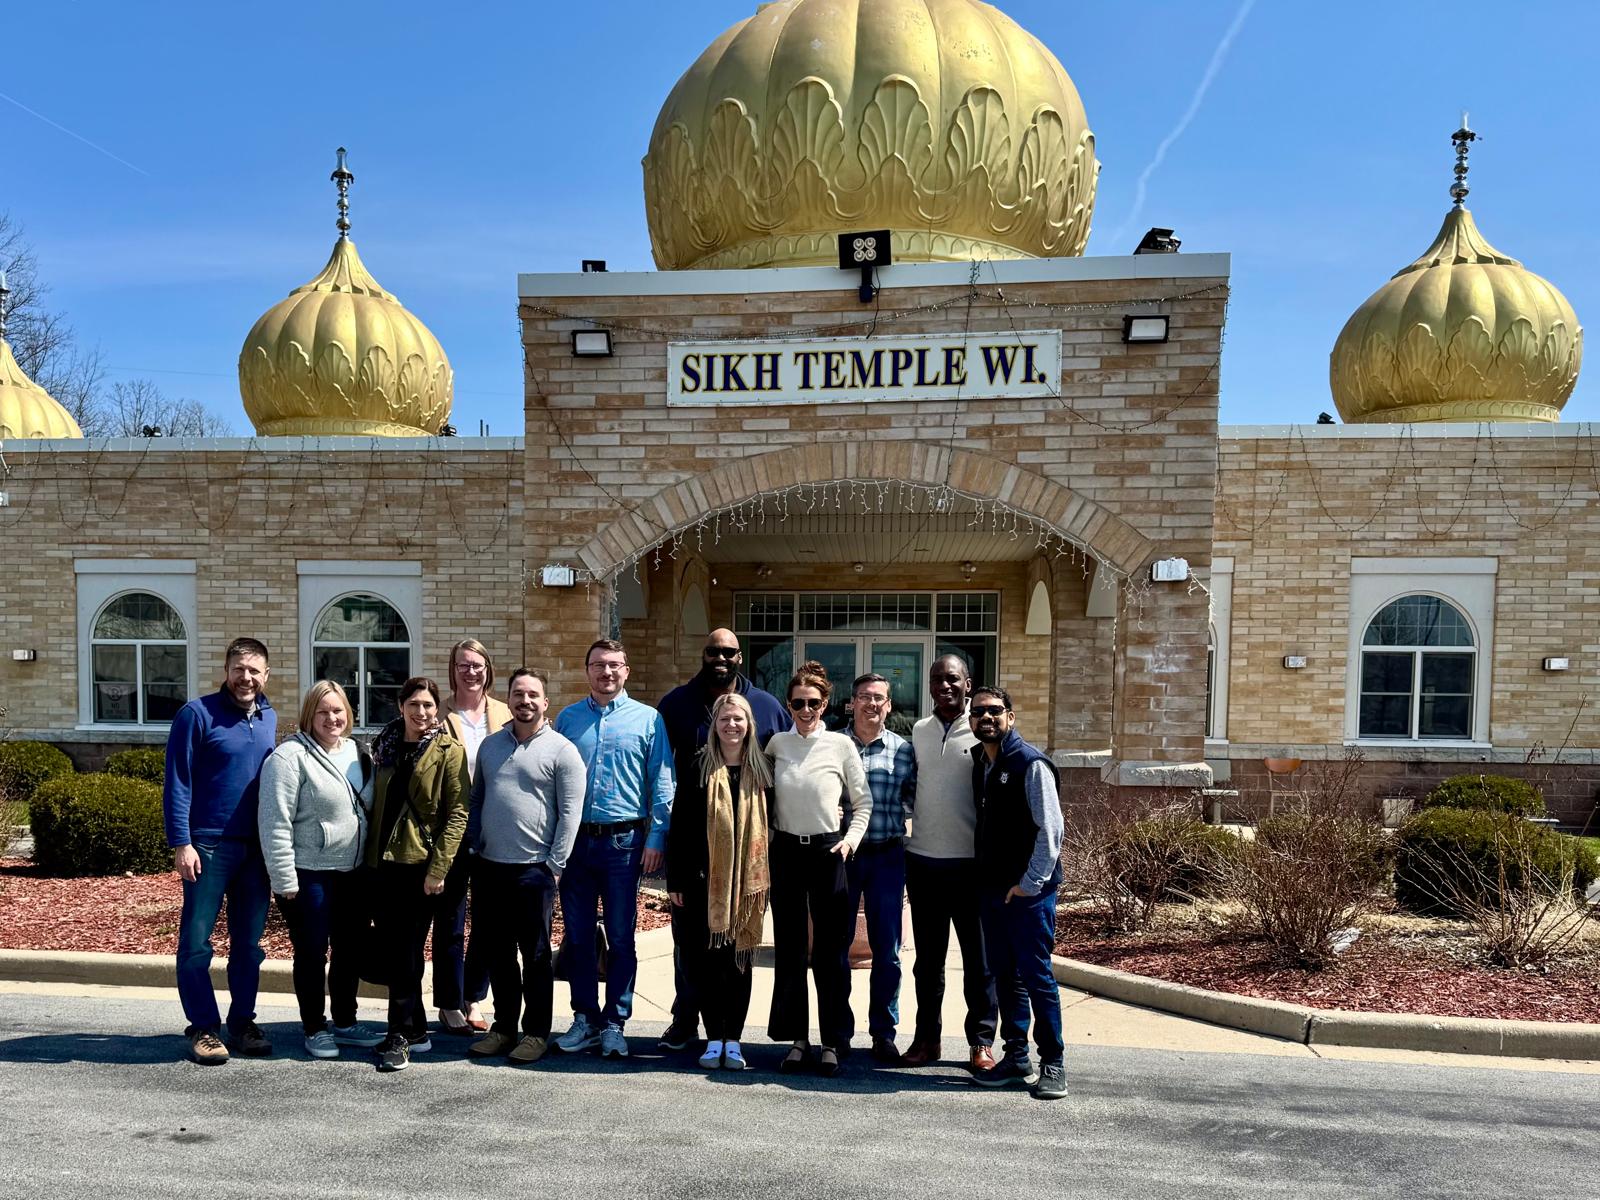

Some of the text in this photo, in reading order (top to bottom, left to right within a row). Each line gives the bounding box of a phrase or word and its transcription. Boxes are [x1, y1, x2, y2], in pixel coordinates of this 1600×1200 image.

[681, 343, 1047, 394] SIKH TEMPLE WI.
